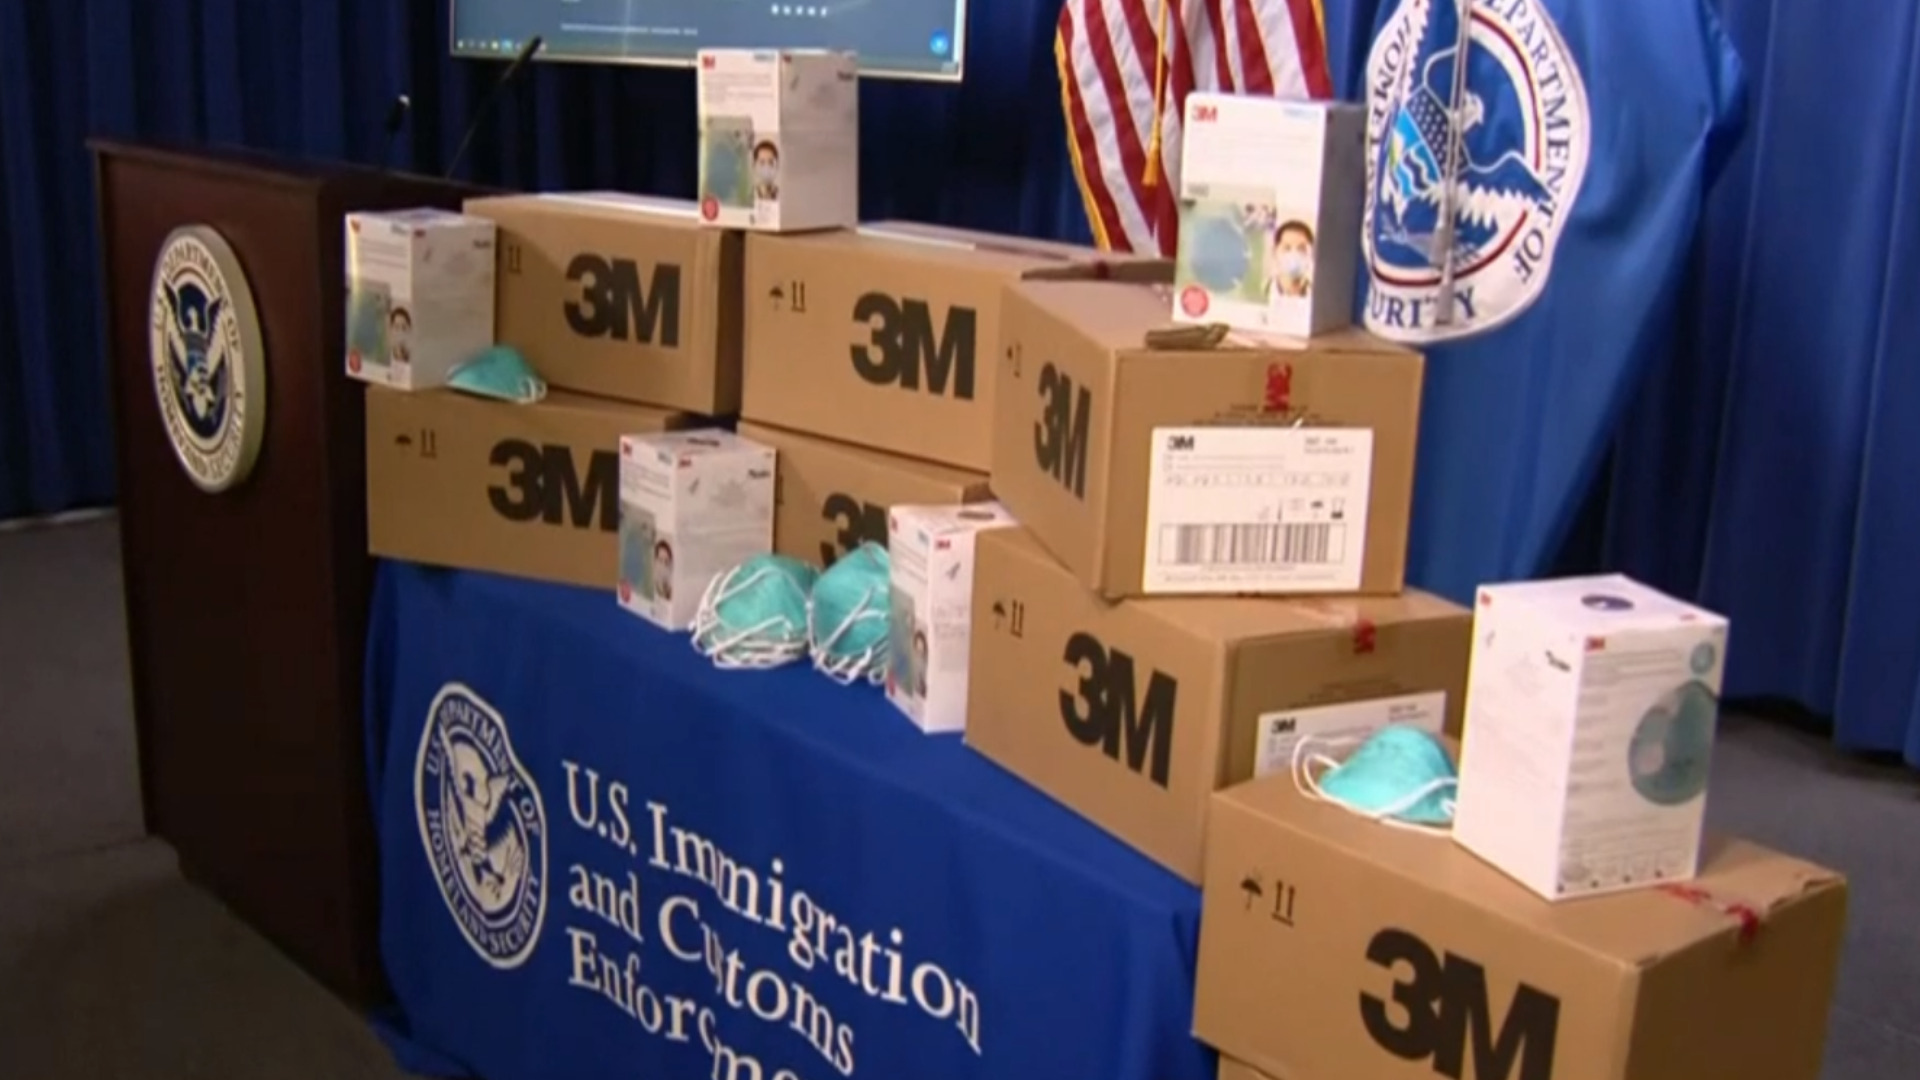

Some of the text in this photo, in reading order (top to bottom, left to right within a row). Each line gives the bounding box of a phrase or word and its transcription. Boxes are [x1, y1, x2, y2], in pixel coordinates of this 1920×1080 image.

[1483, 0, 1570, 227] EPARTMENT
[563, 253, 681, 347] 3M
[1513, 228, 1545, 284] OF
[850, 291, 976, 401] 3M
[487, 438, 620, 533] 3M
[1035, 362, 1091, 499] 3M
[1167, 435, 1194, 451] 3M
[1060, 632, 1177, 789] 3M
[1271, 718, 1296, 735] 3M
[562, 759, 982, 1055] U.S. Immigration
[568, 862, 854, 1077] and Cutoms
[1360, 928, 1561, 1080] 3M
